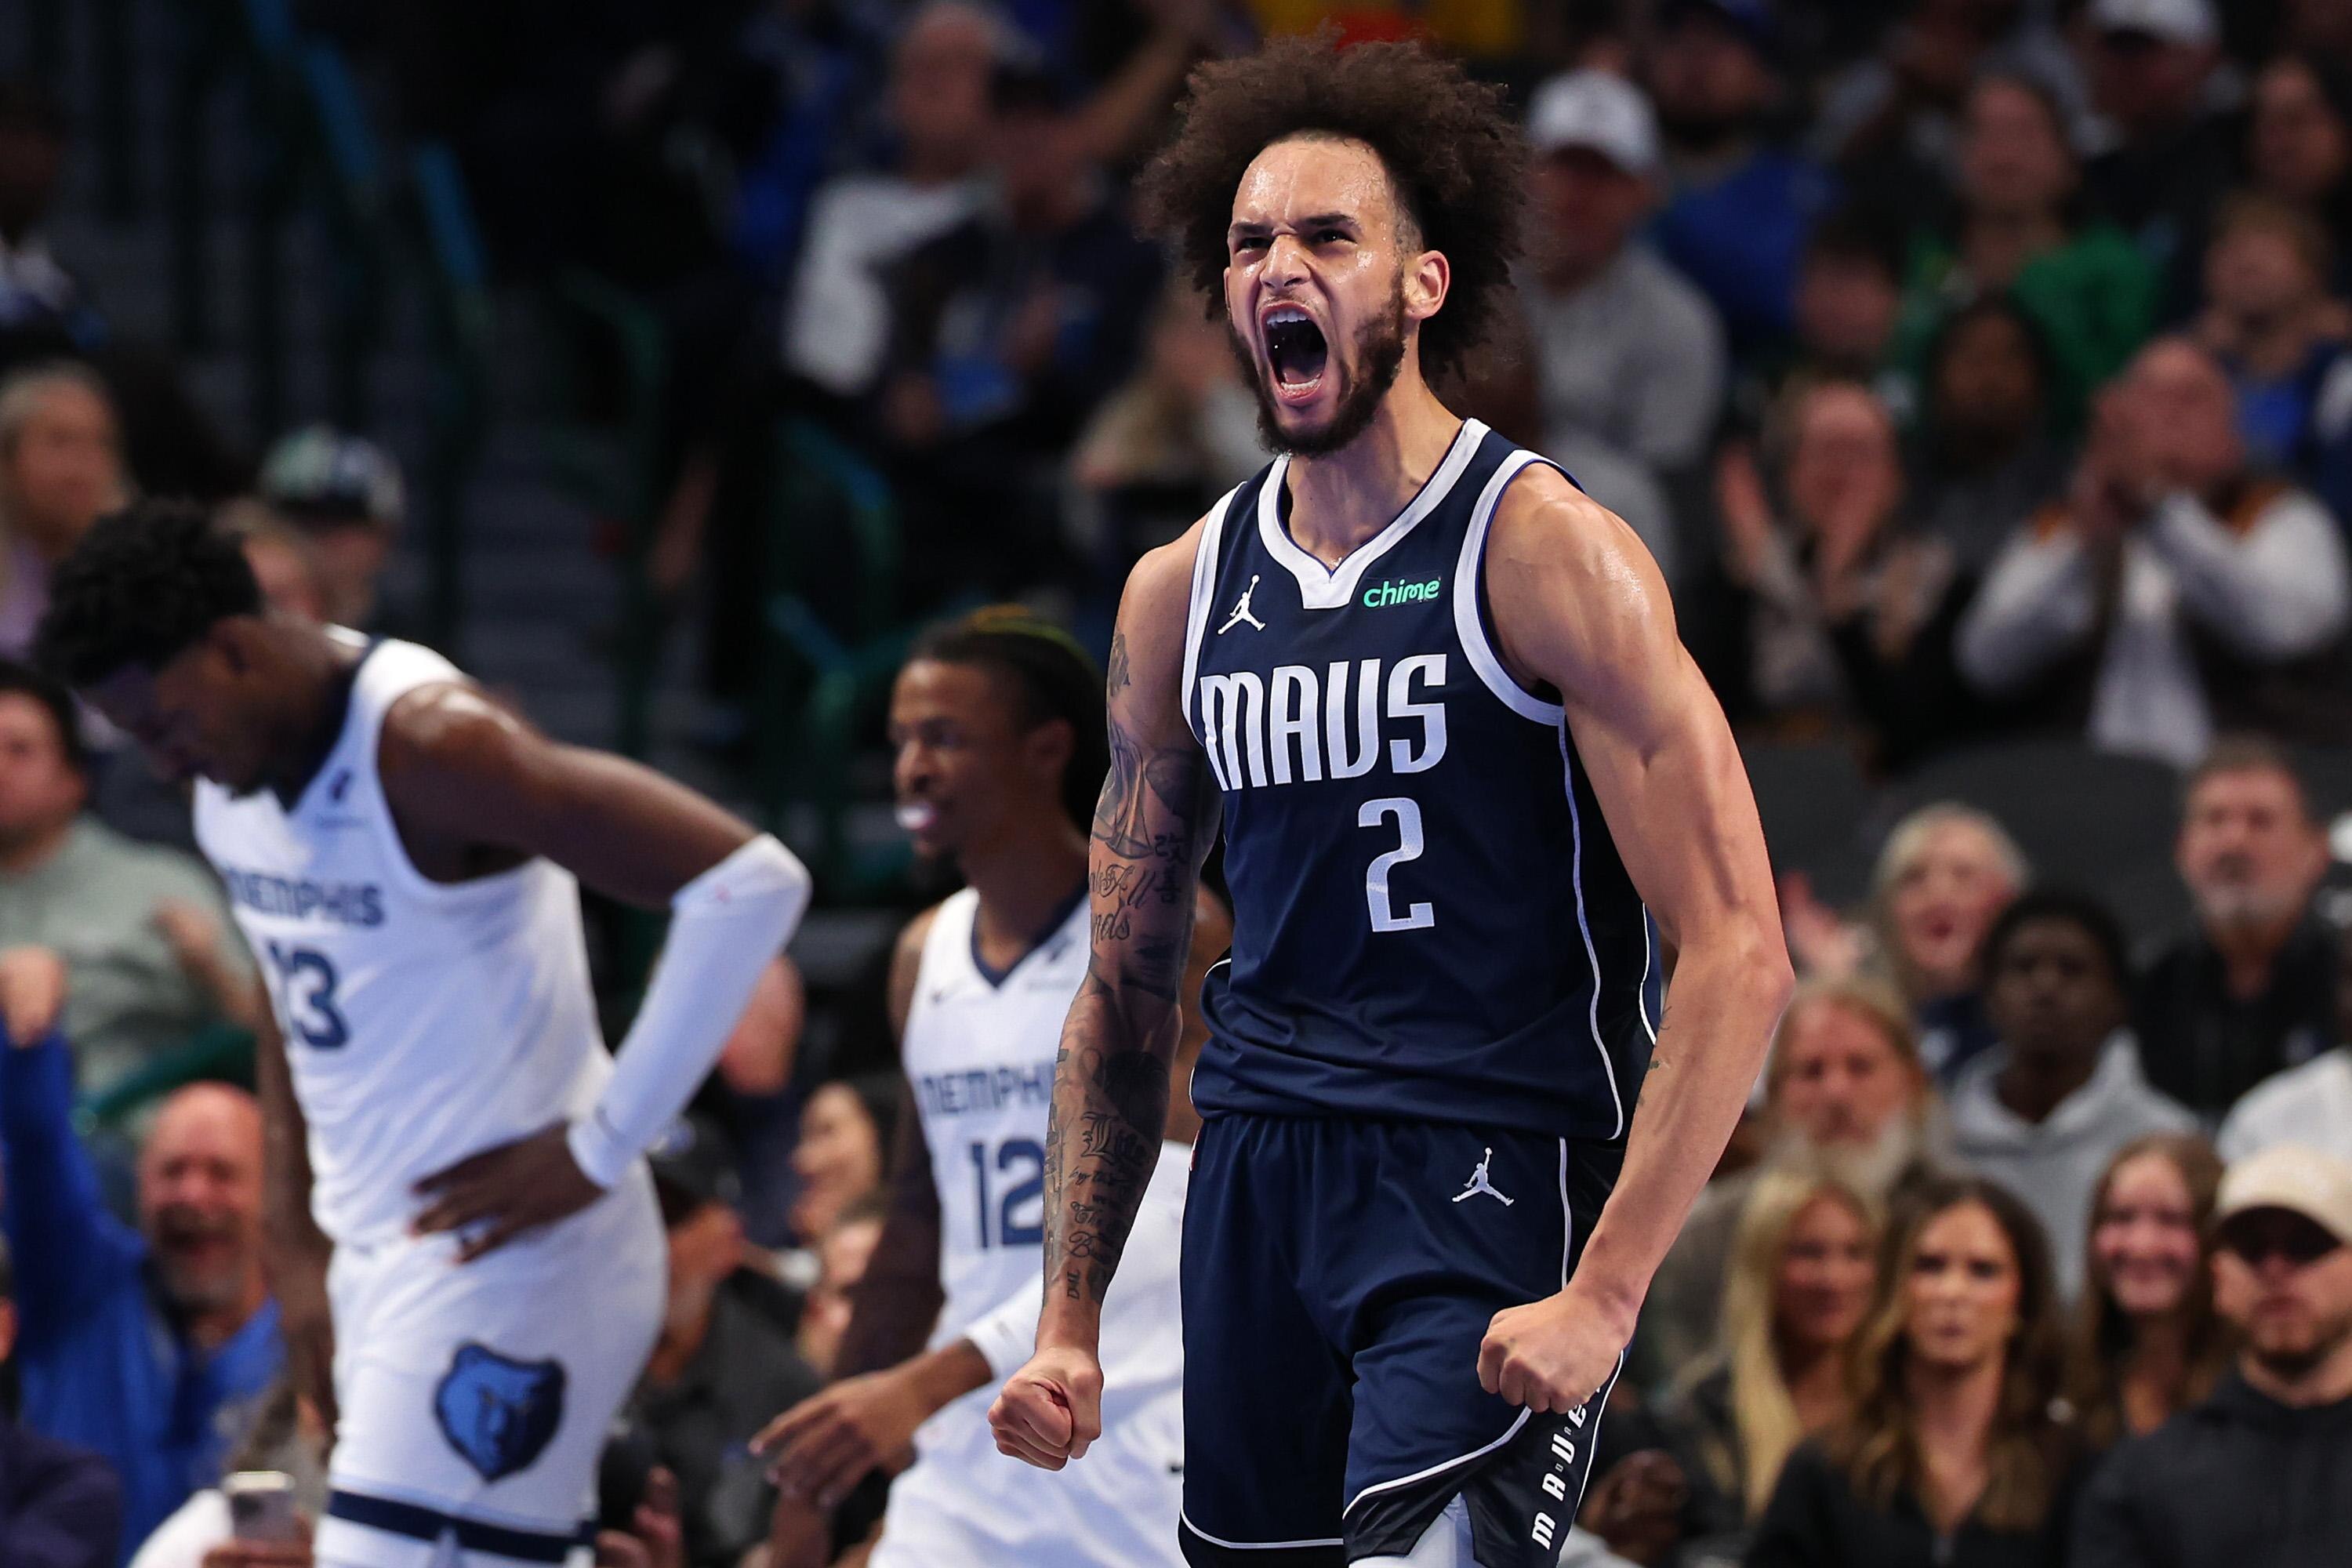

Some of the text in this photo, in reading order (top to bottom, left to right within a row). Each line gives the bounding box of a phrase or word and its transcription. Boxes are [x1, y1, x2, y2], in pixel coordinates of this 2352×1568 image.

[1363, 579, 1440, 608] chime
[1358, 797, 1436, 933] 2
[969, 1135, 1044, 1250] 12
